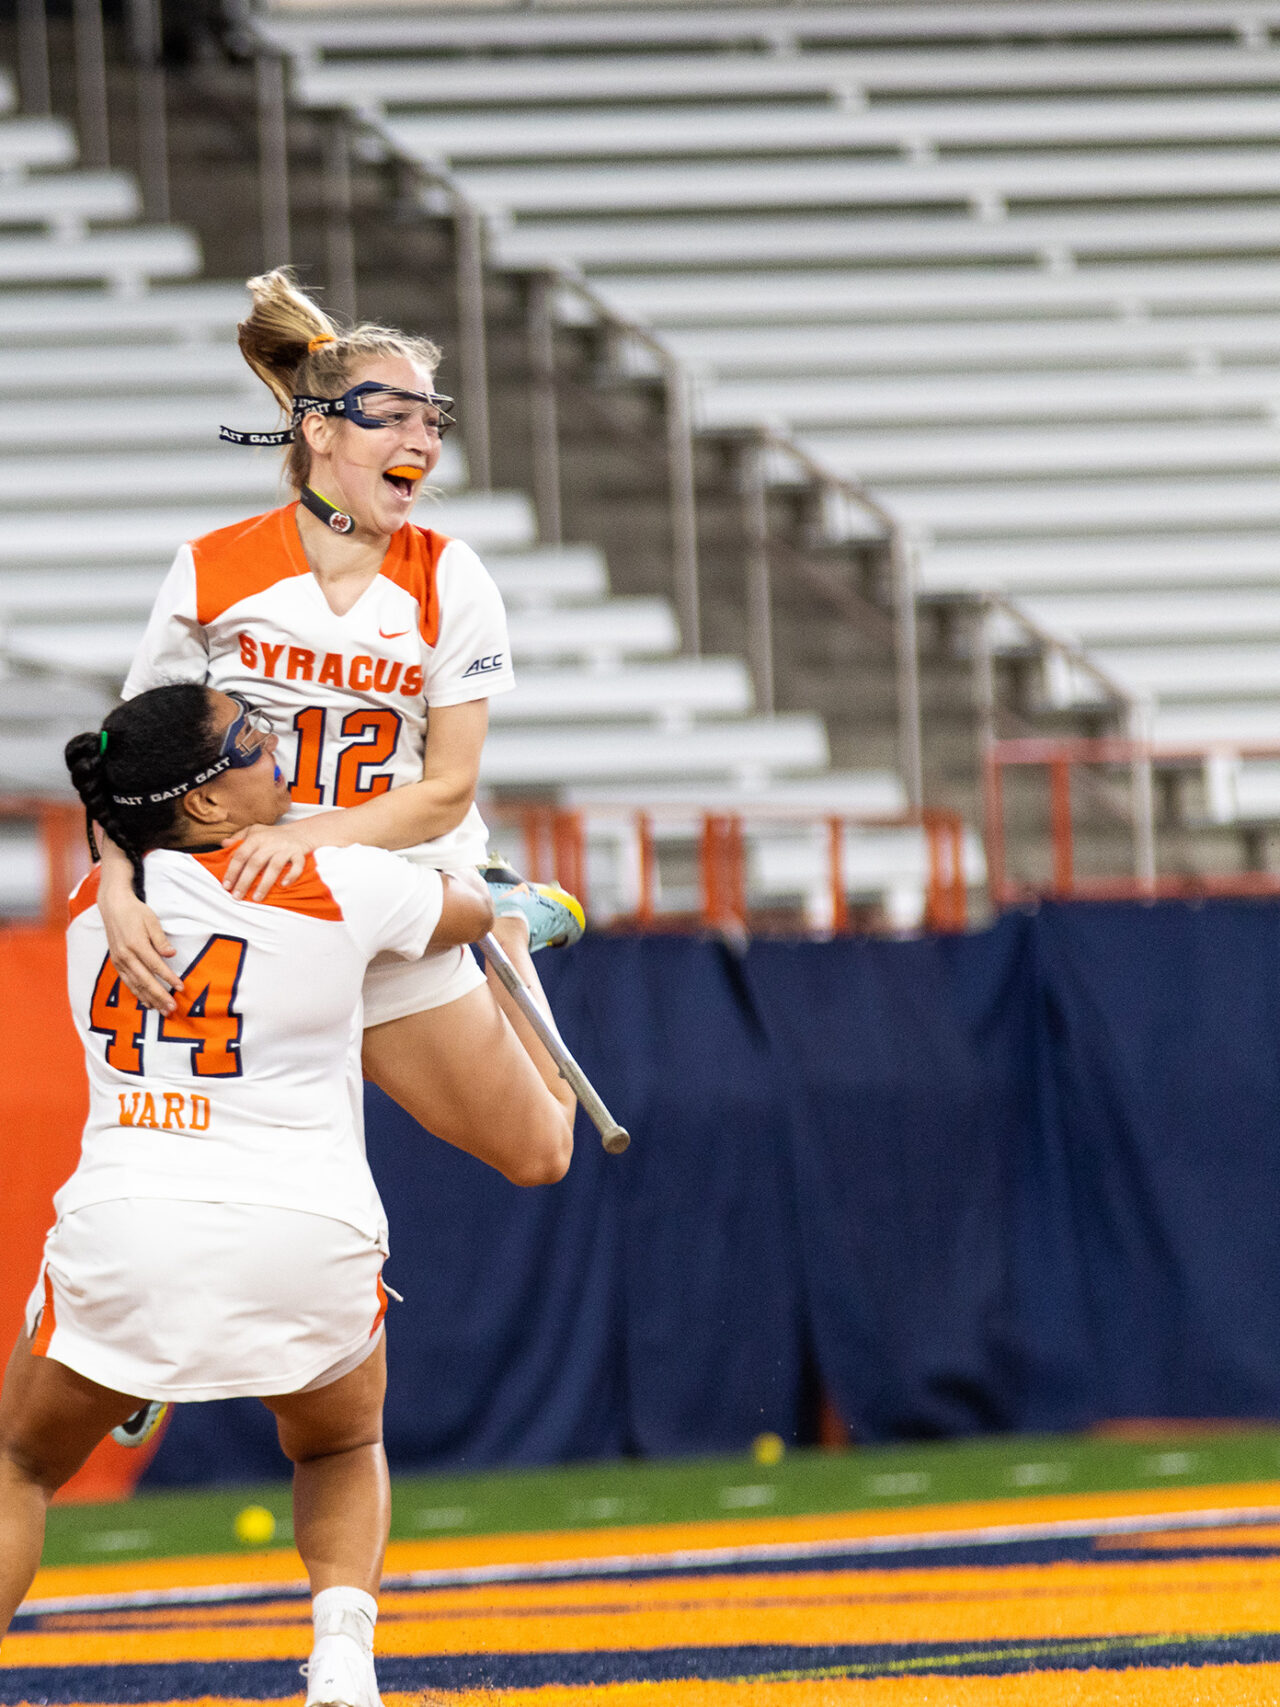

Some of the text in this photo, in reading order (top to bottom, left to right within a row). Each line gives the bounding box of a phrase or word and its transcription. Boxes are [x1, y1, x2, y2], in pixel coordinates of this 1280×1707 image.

[220, 428, 244, 442] AIT
[249, 434, 285, 444] GAIT
[464, 653, 503, 675] ACC
[287, 705, 403, 808] 12
[113, 756, 232, 806] GAIT GAIT GAIT
[89, 933, 249, 1079] 44
[118, 1092, 211, 1131] WARD
